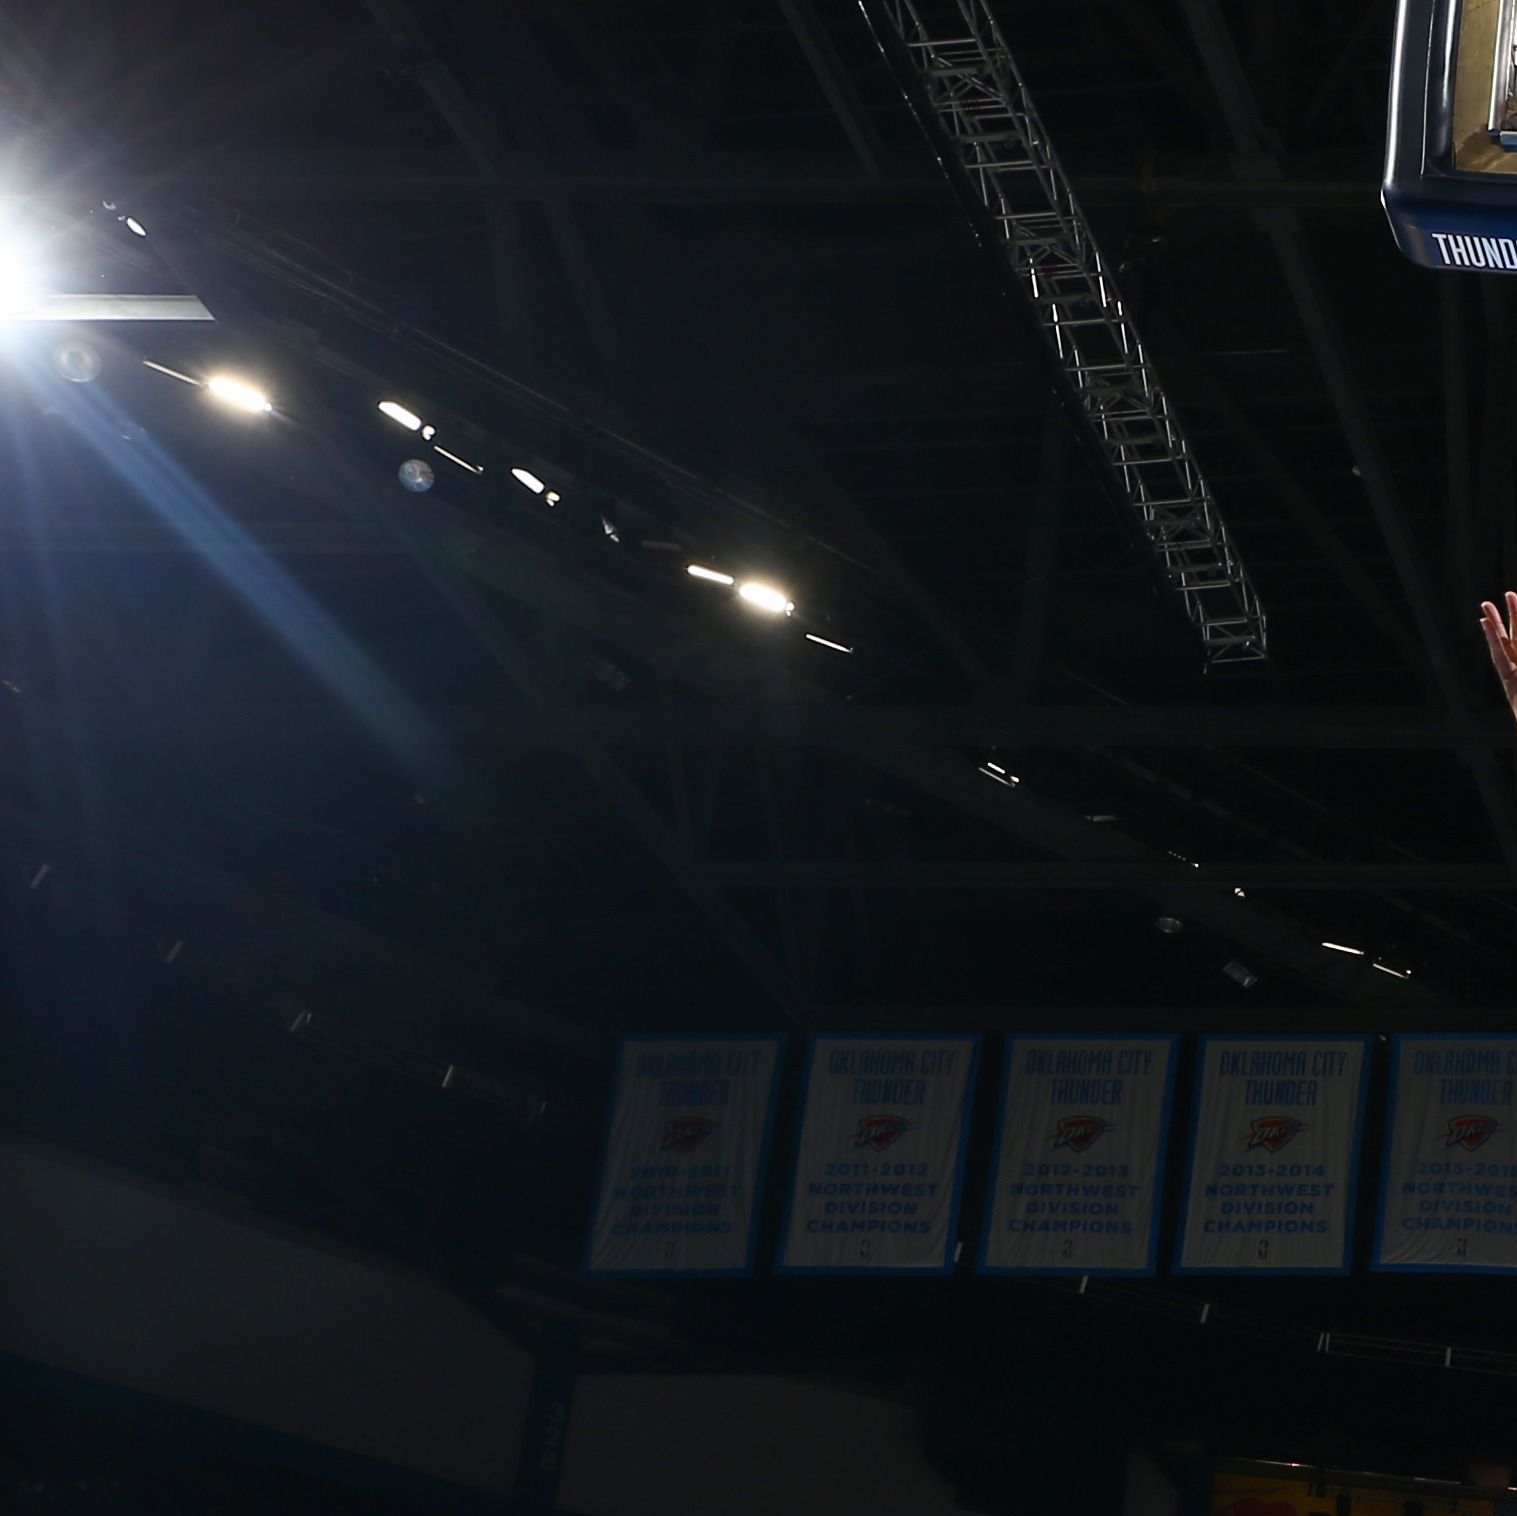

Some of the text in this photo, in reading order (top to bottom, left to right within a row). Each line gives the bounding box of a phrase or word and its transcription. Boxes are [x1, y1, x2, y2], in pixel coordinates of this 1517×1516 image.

[829, 1049, 954, 1076] OKLAHOMA CITY
[1219, 1050, 1347, 1077] OKLAHOMA CITY
[1413, 1050, 1500, 1076] OKLAHOMA
[853, 1079, 924, 1105] THUNDER
[1244, 1079, 1317, 1106] THUNDER
[1439, 1079, 1513, 1106] THUNDER
[825, 1162, 929, 1177] 2011-2012
[1219, 1163, 1325, 1178] 2013-2014
[809, 1183, 938, 1197] NORTHWEST
[1205, 1182, 1335, 1198] NORTHWEST
[825, 1201, 917, 1215] DIVISION
[1221, 1201, 1315, 1216] DIVISION
[1419, 1199, 1512, 1216] DIVISION
[806, 1219, 931, 1234] CHAMPIONS
[1204, 1219, 1329, 1234] CHAMPIONS
